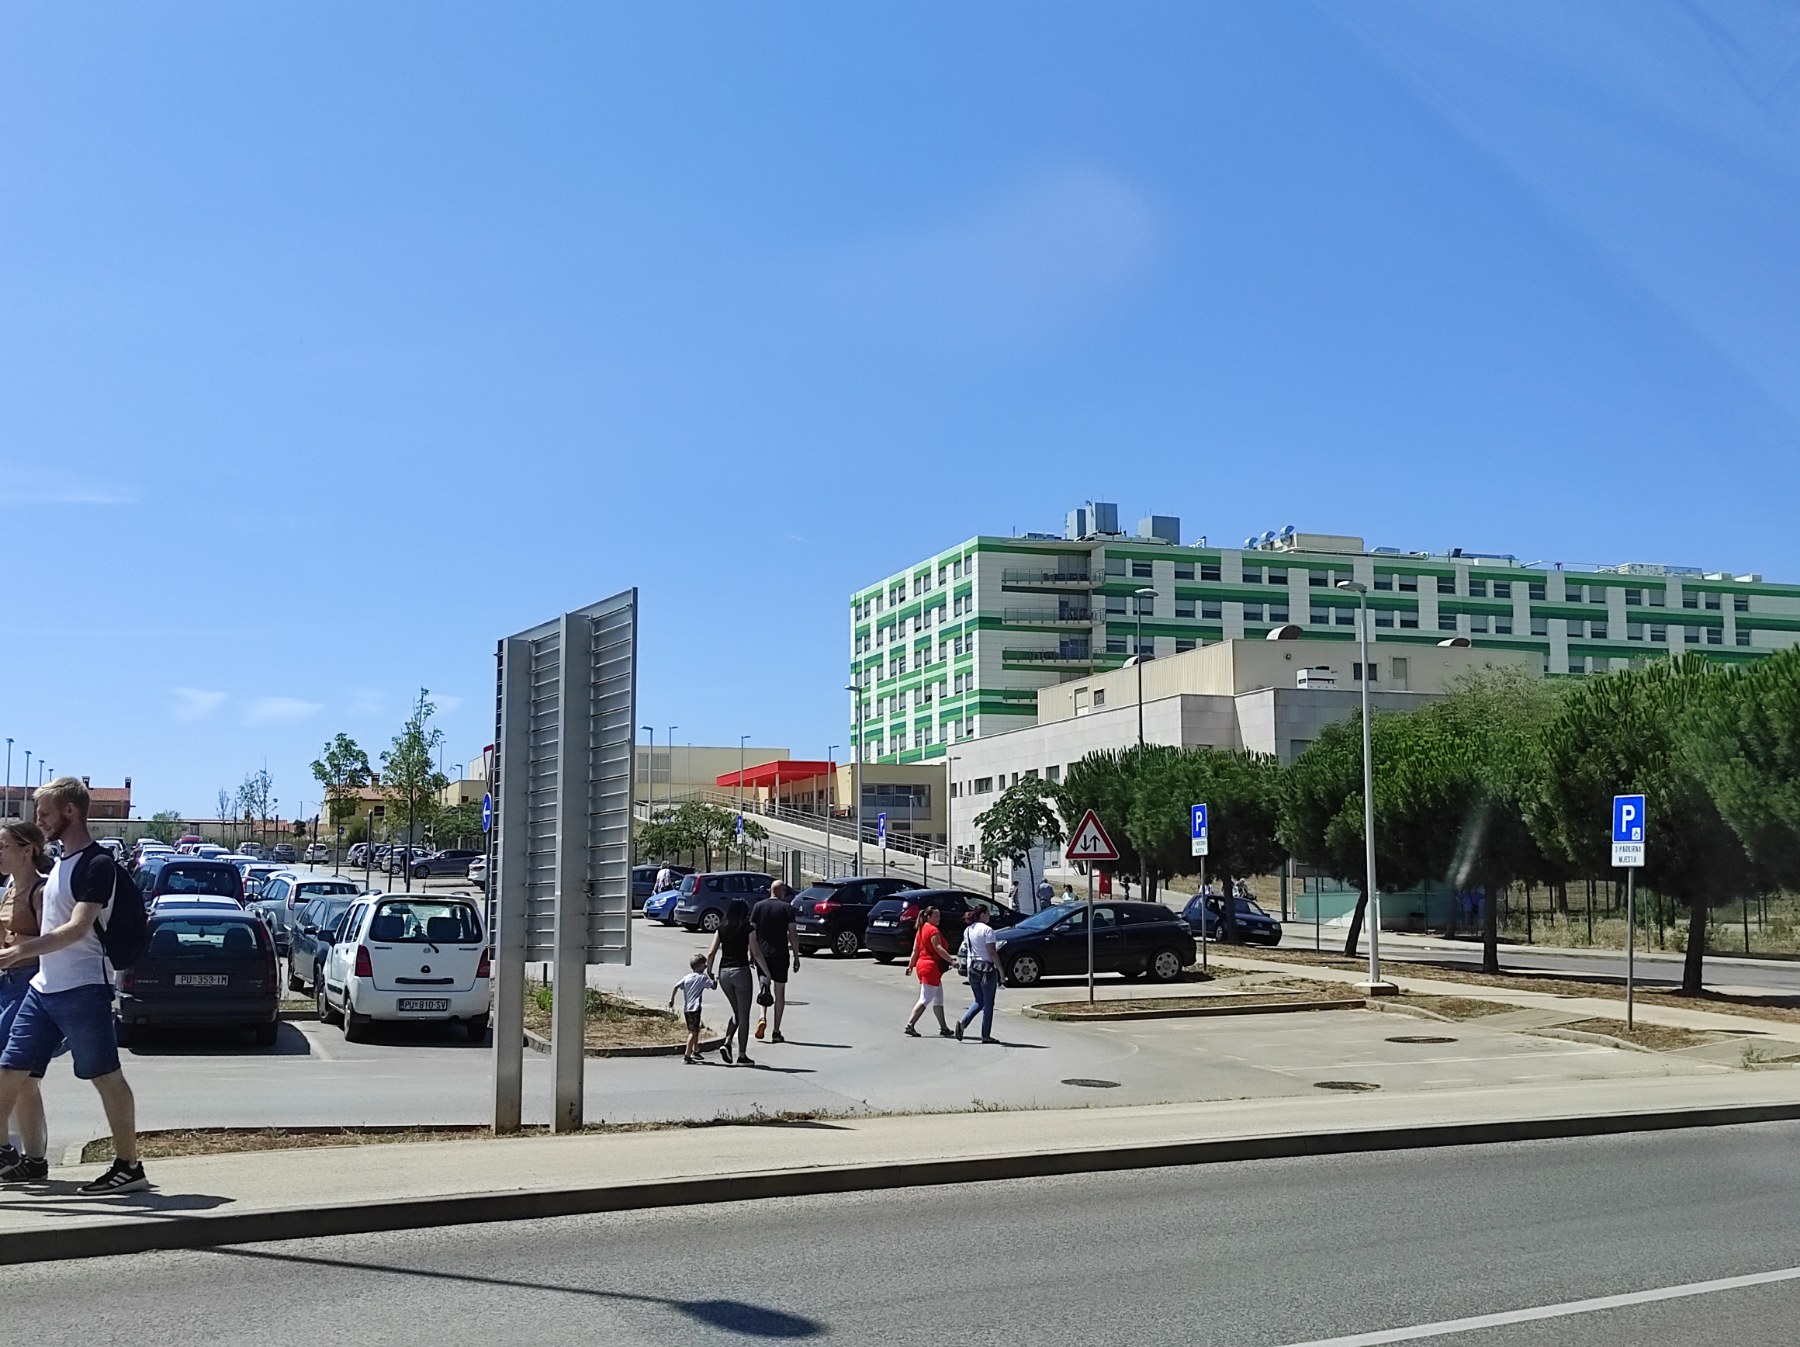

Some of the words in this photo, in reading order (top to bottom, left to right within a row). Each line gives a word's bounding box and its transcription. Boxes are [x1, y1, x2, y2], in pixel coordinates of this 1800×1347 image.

[1196, 811, 1203, 831] P
[1622, 805, 1635, 832] P
[181, 975, 192, 984] PU
[403, 1001, 415, 1010] PU
